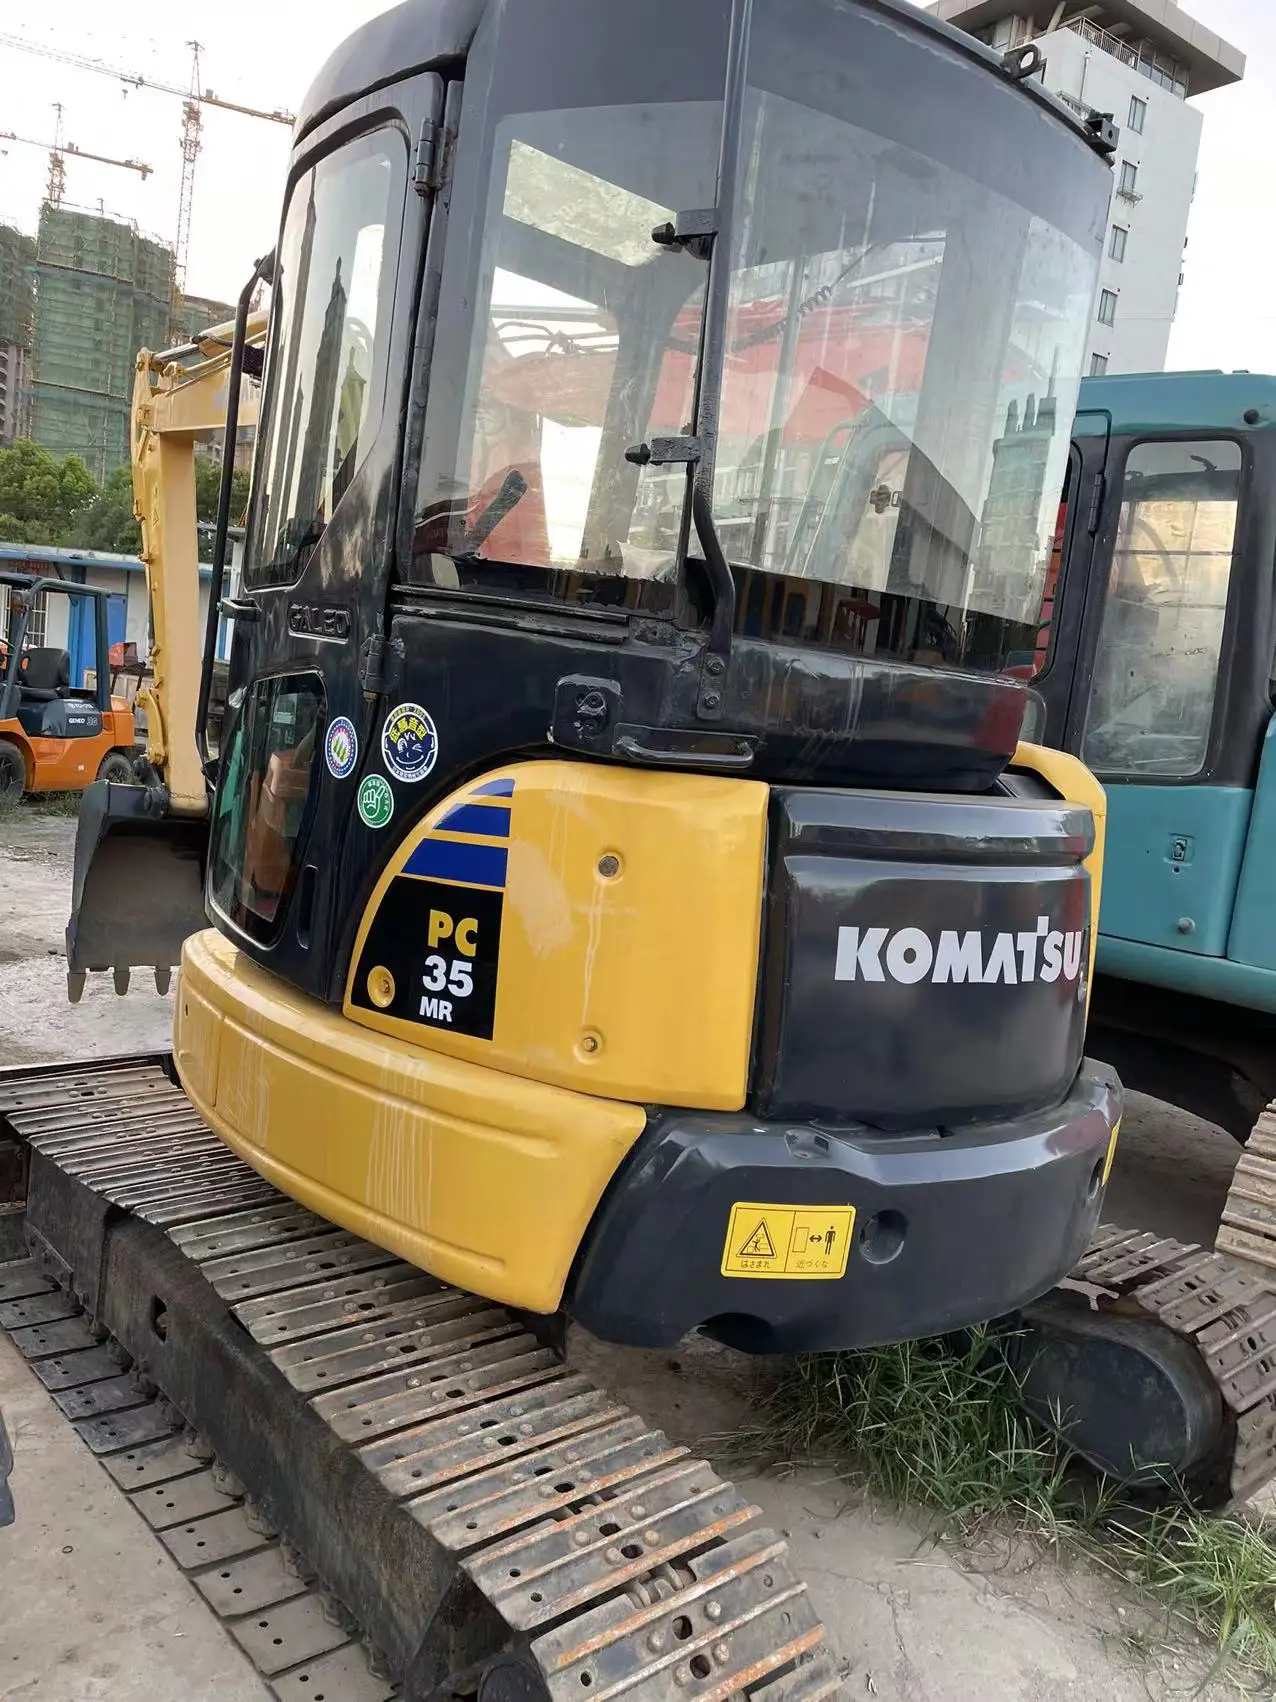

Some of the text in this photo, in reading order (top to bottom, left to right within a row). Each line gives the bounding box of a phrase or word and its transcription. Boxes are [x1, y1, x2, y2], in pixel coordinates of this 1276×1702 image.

[427, 909, 479, 957] PC
[834, 916, 1082, 984] KOMATSU
[422, 955, 474, 998] 35
[419, 996, 453, 1022] MR
[740, 1259, 770, 1269] はさまれ
[795, 1259, 829, 1269] 近づくな
